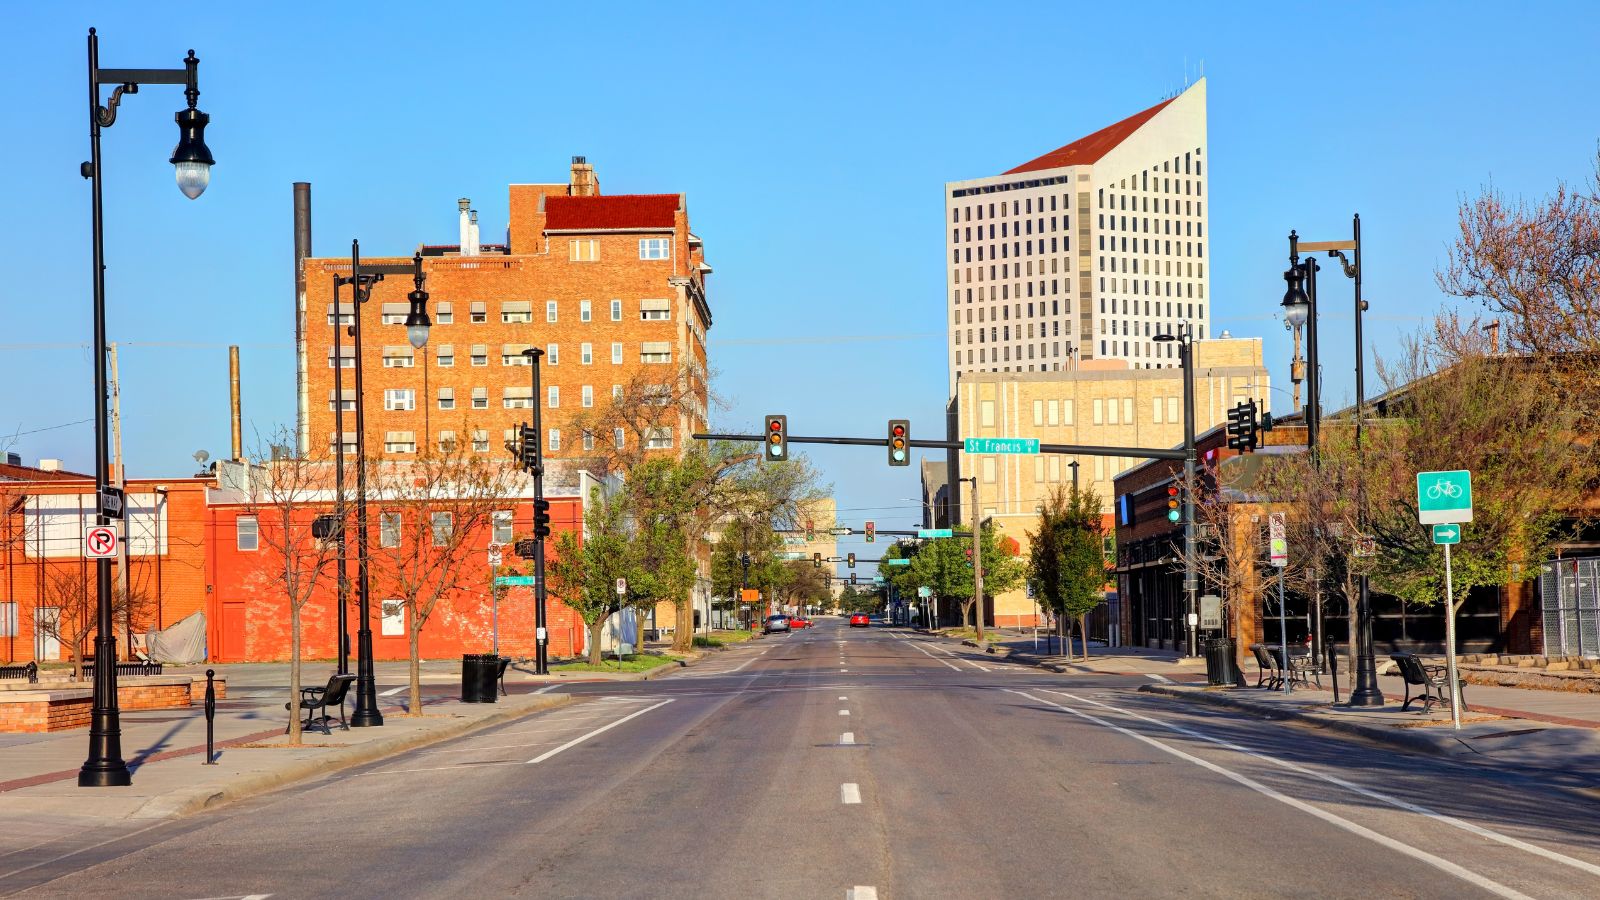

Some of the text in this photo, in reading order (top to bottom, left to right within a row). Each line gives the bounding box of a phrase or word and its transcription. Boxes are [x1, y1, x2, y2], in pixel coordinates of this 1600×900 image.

[969, 440, 1021, 453] St Francis
[97, 533, 110, 550] P
